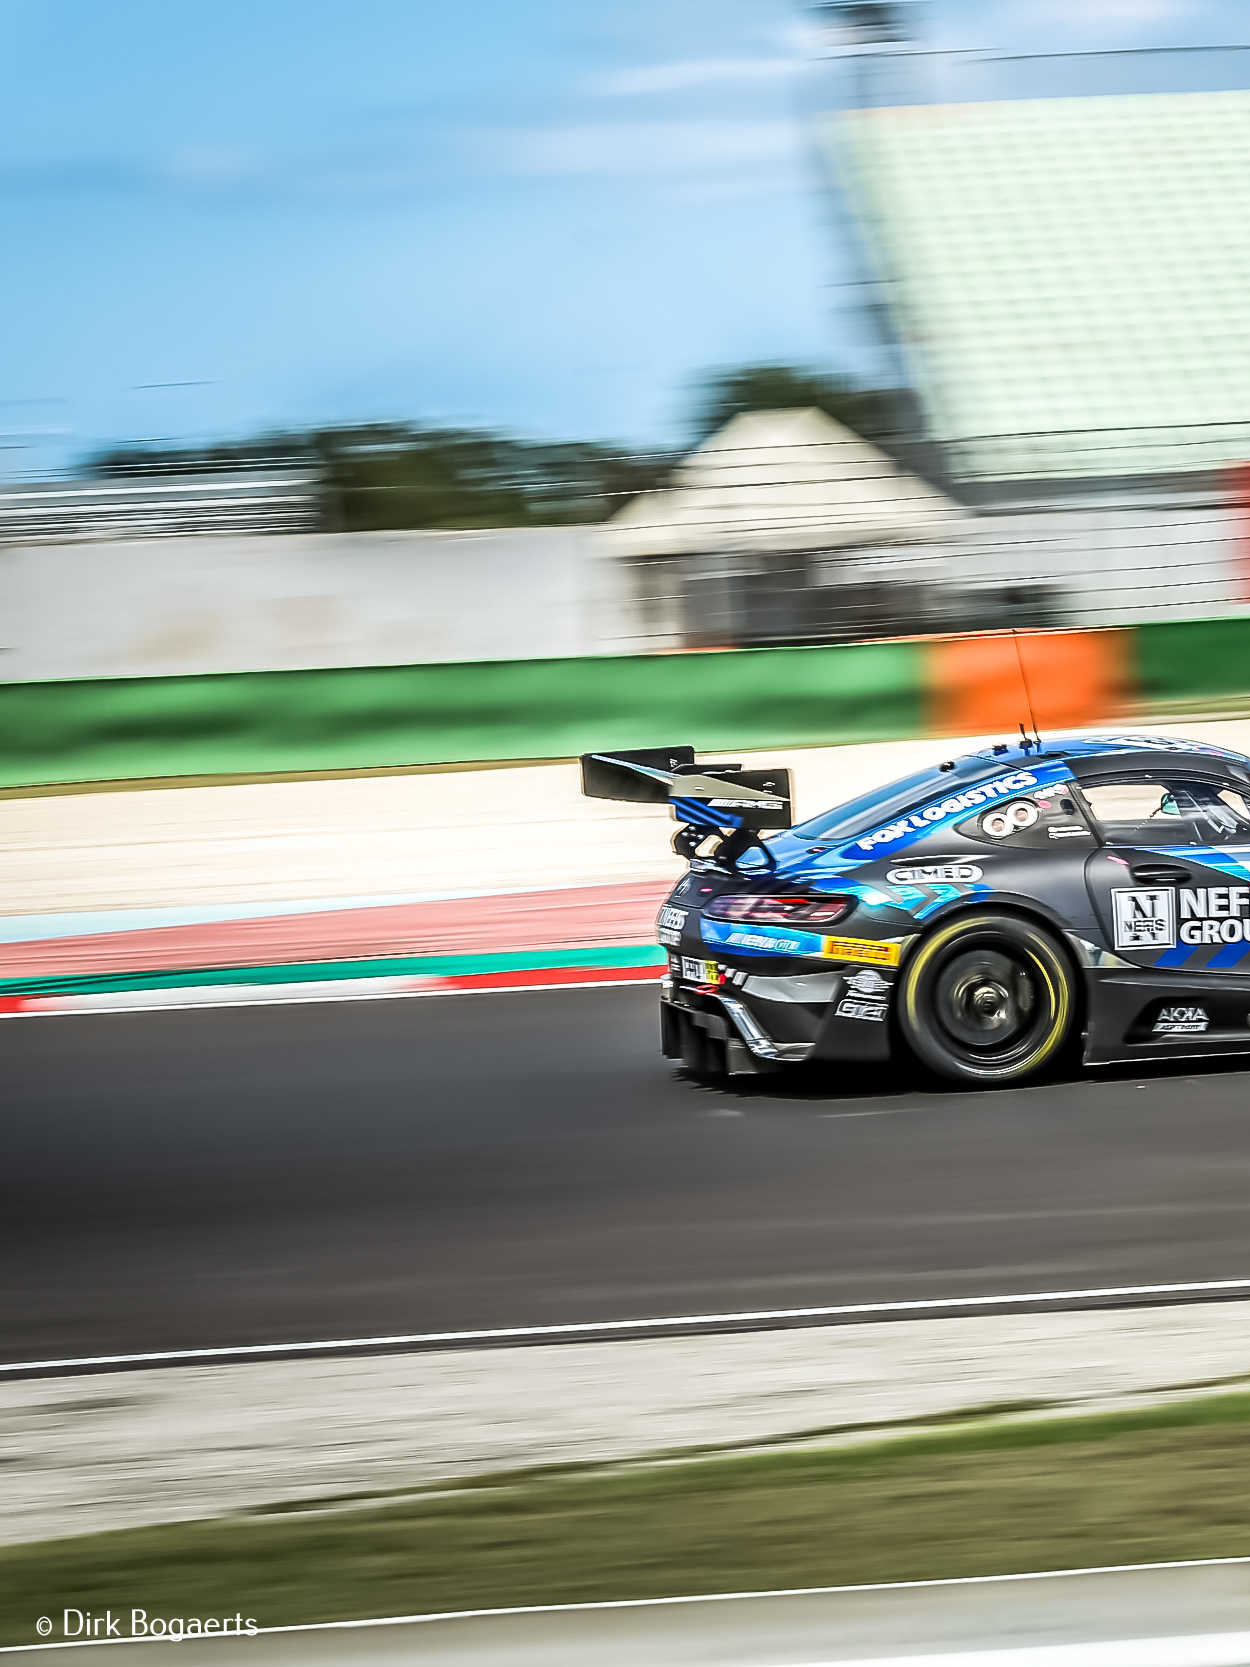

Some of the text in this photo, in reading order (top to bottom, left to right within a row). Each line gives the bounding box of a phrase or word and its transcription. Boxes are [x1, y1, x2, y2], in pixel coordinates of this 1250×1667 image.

[856, 772, 1038, 850] FOX LOGISTICS
[895, 866, 974, 881] CIMED
